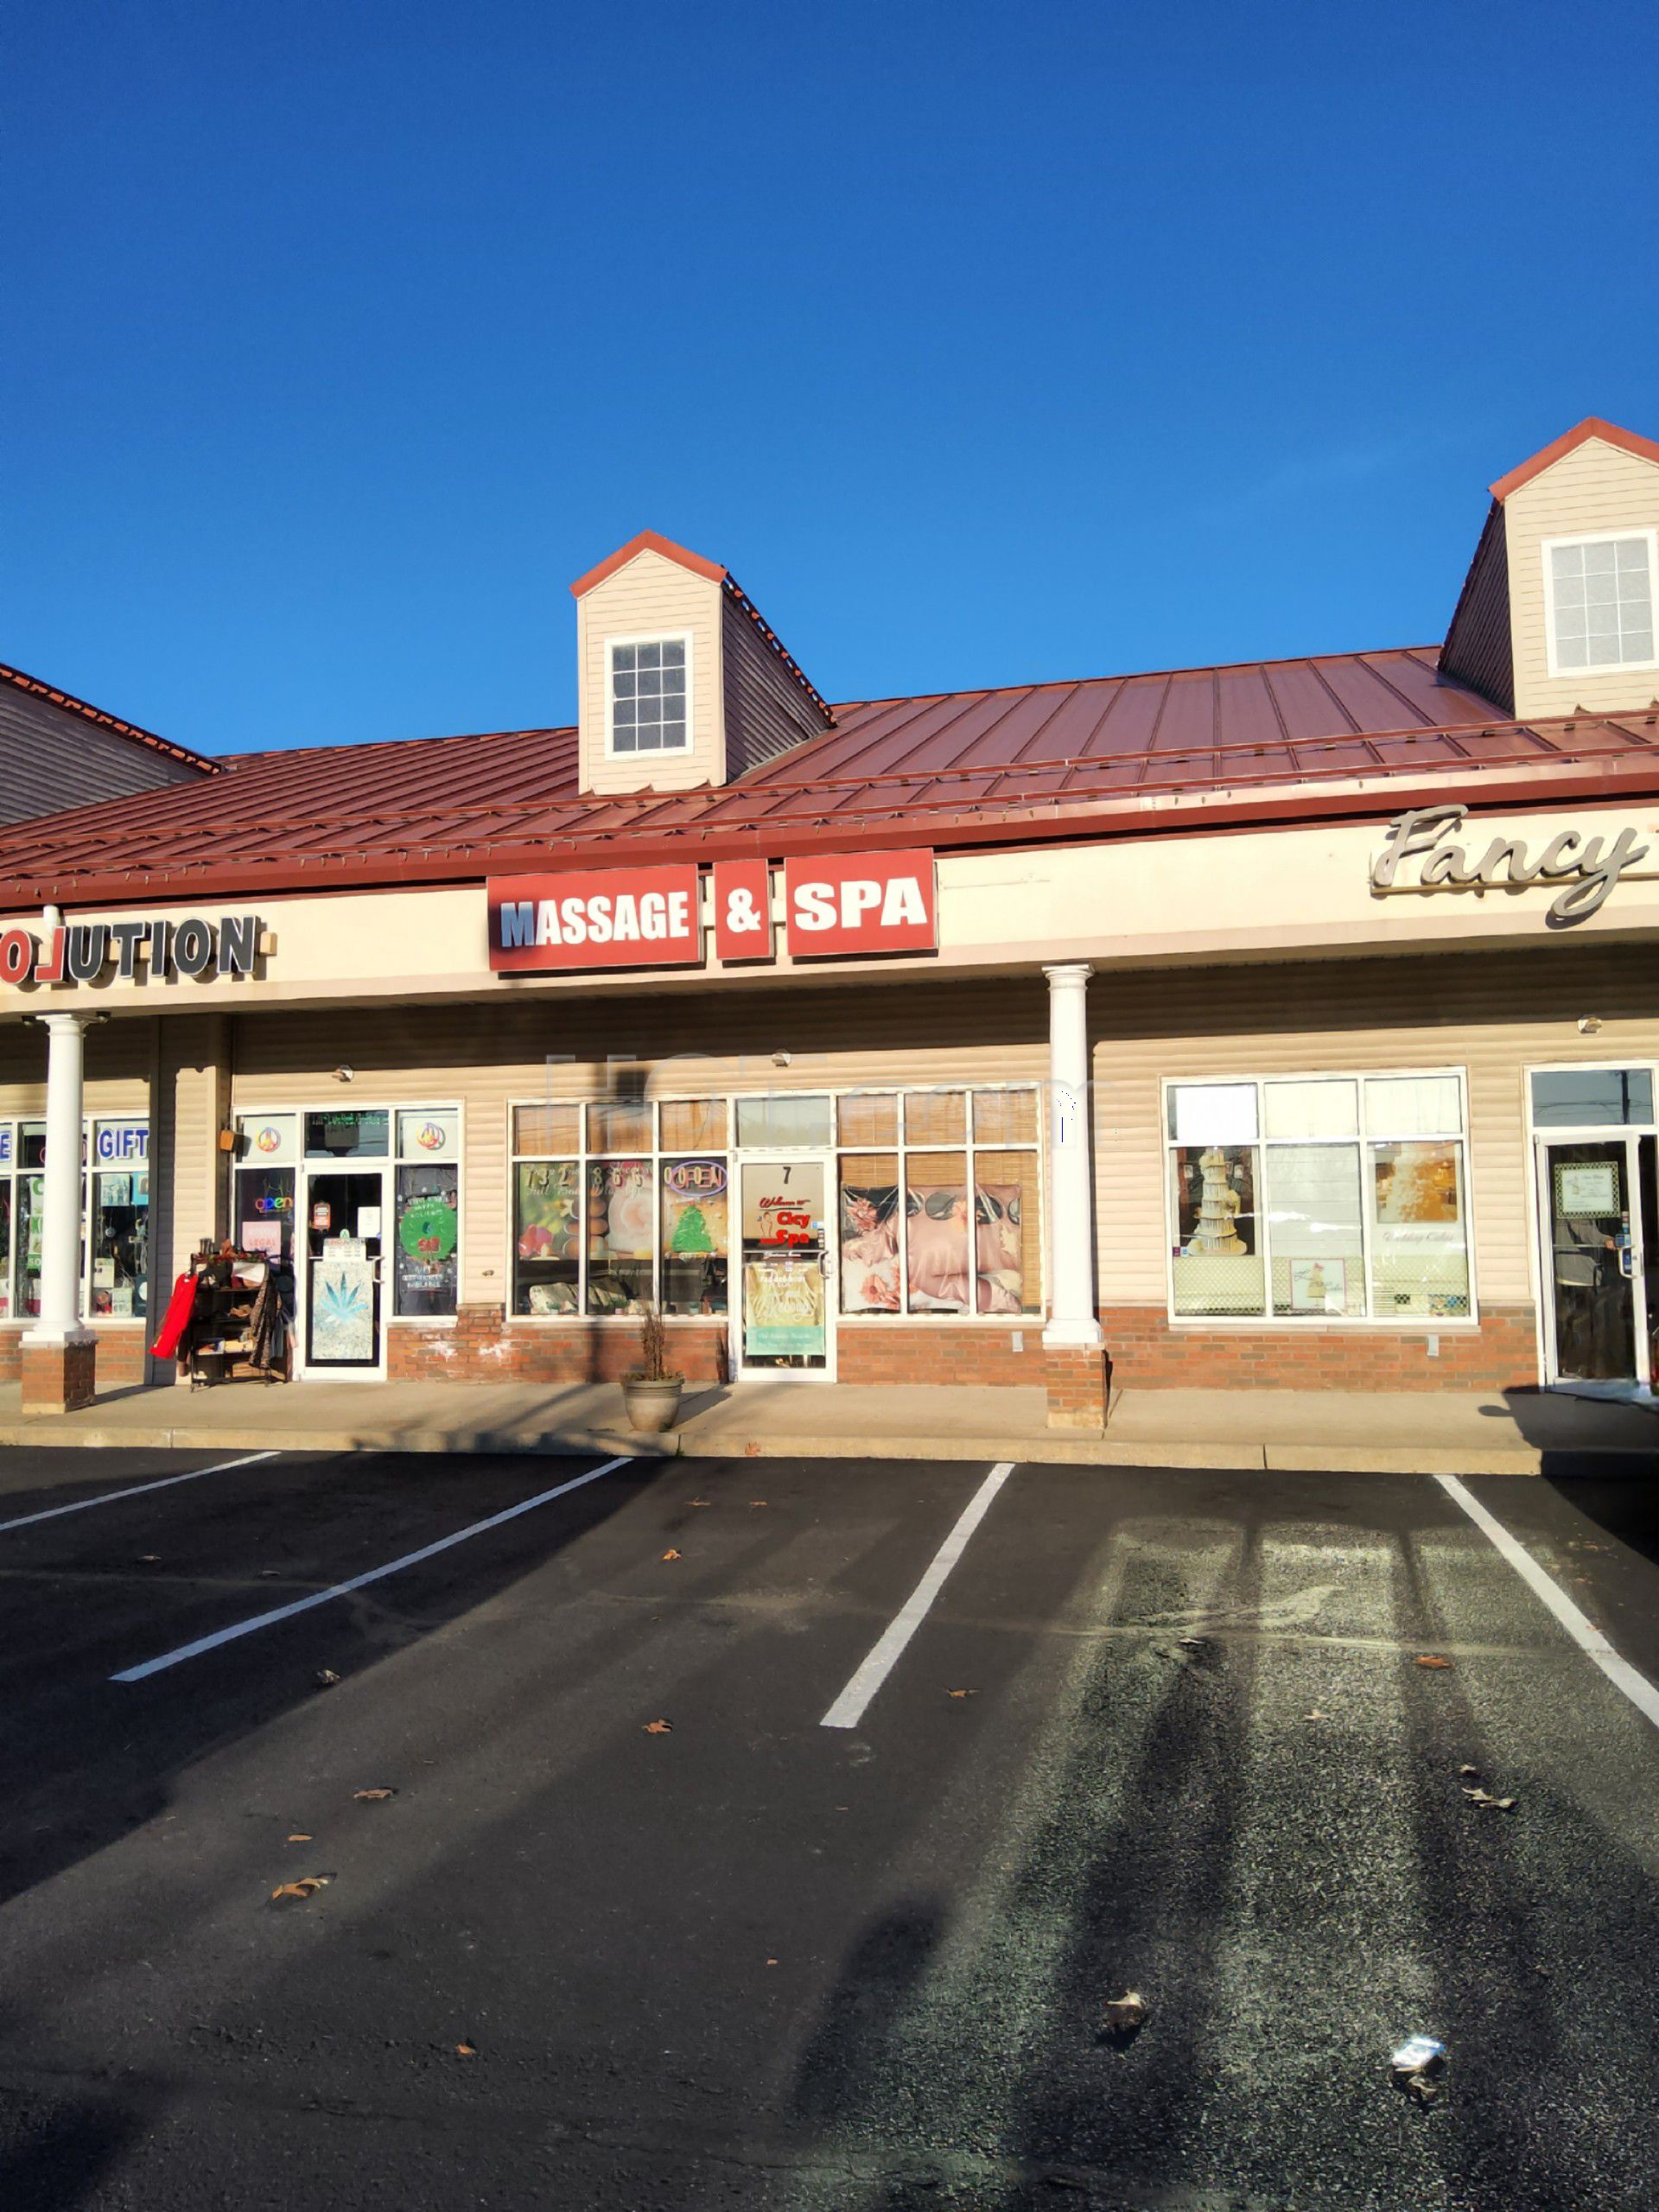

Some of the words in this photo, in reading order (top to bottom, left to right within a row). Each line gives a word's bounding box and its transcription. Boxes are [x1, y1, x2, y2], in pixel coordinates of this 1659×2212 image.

[1373, 804, 1649, 916] Fancy
[500, 891, 690, 947] MASSAGE
[727, 887, 761, 933] &
[793, 877, 928, 932] SPA
[783, 1166, 791, 1184] 7
[256, 1197, 293, 1211] open
[775, 1230, 810, 1249] Spa
